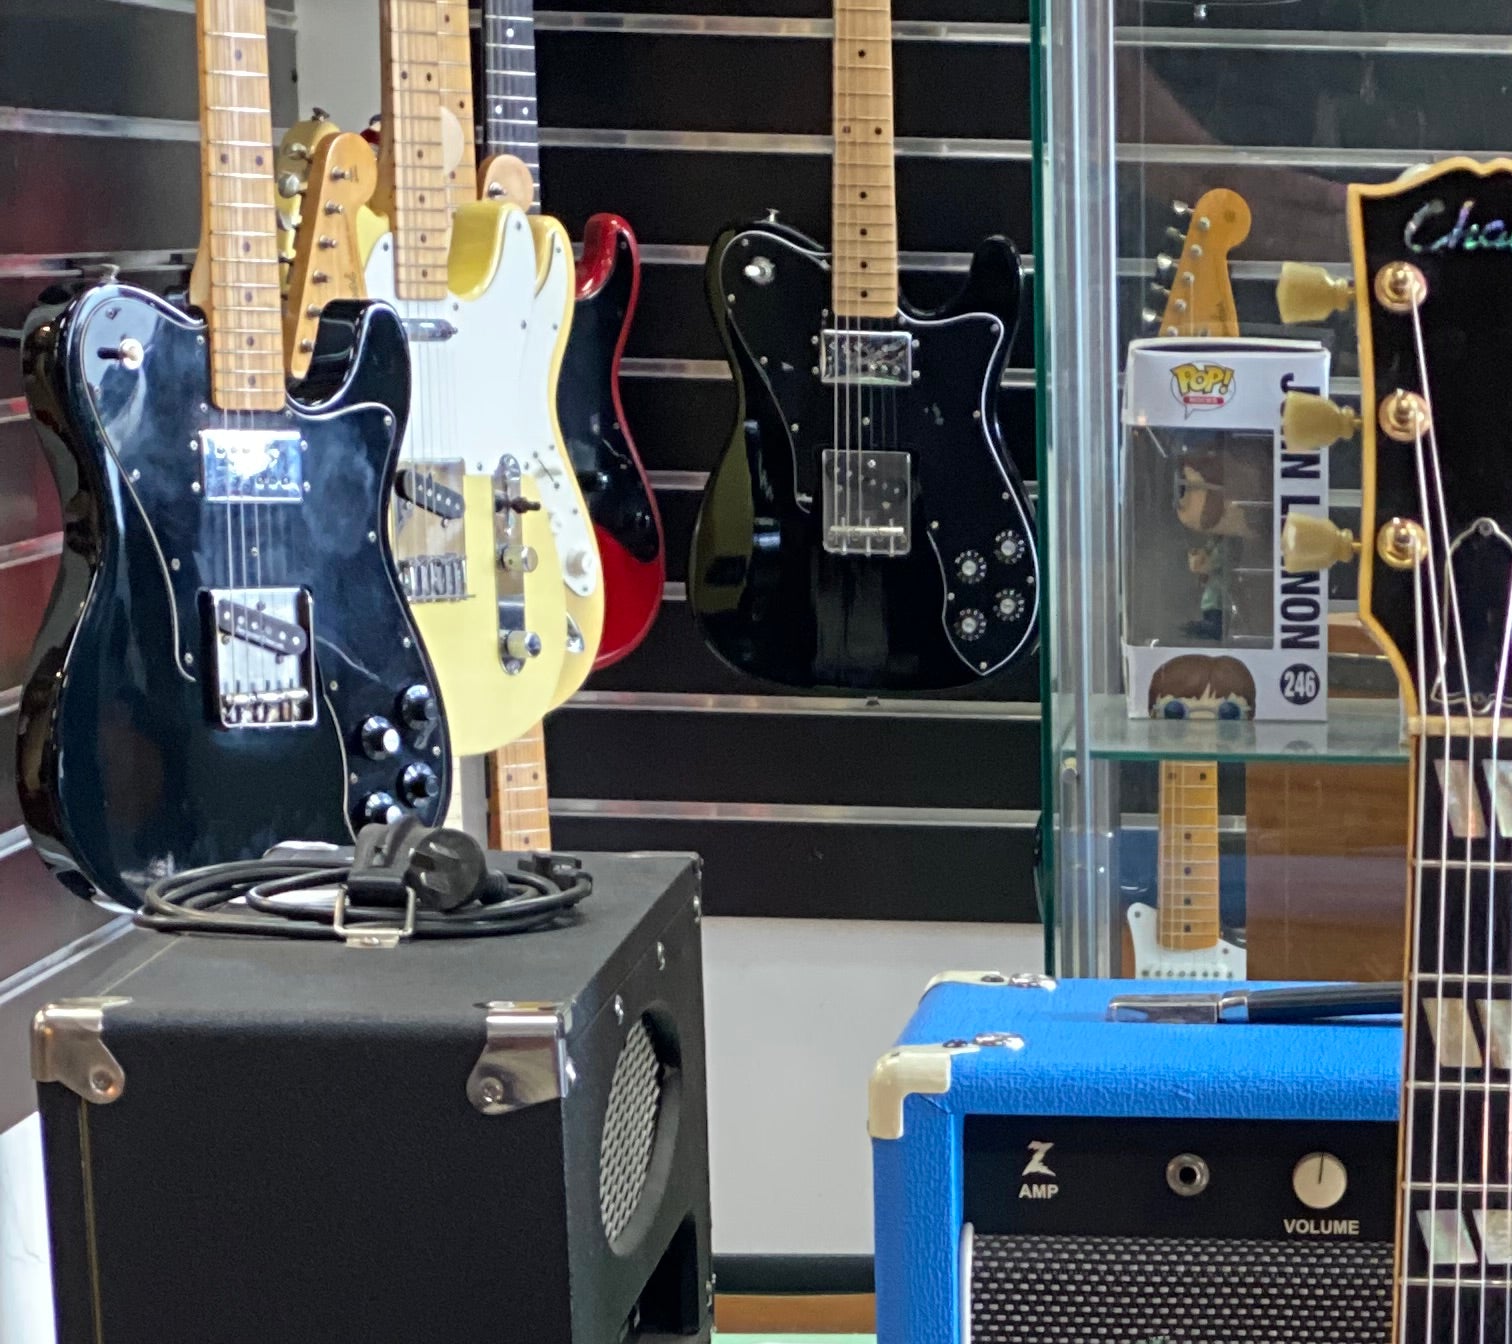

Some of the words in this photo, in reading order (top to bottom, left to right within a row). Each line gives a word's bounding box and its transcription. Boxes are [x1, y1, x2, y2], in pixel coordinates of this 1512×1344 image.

[1170, 362, 1235, 396] POP!
[1280, 372, 1321, 479] JN
[1284, 672, 1317, 698] 246
[1018, 1184, 1059, 1199] AMP
[1283, 1218, 1360, 1235] VOLUME
